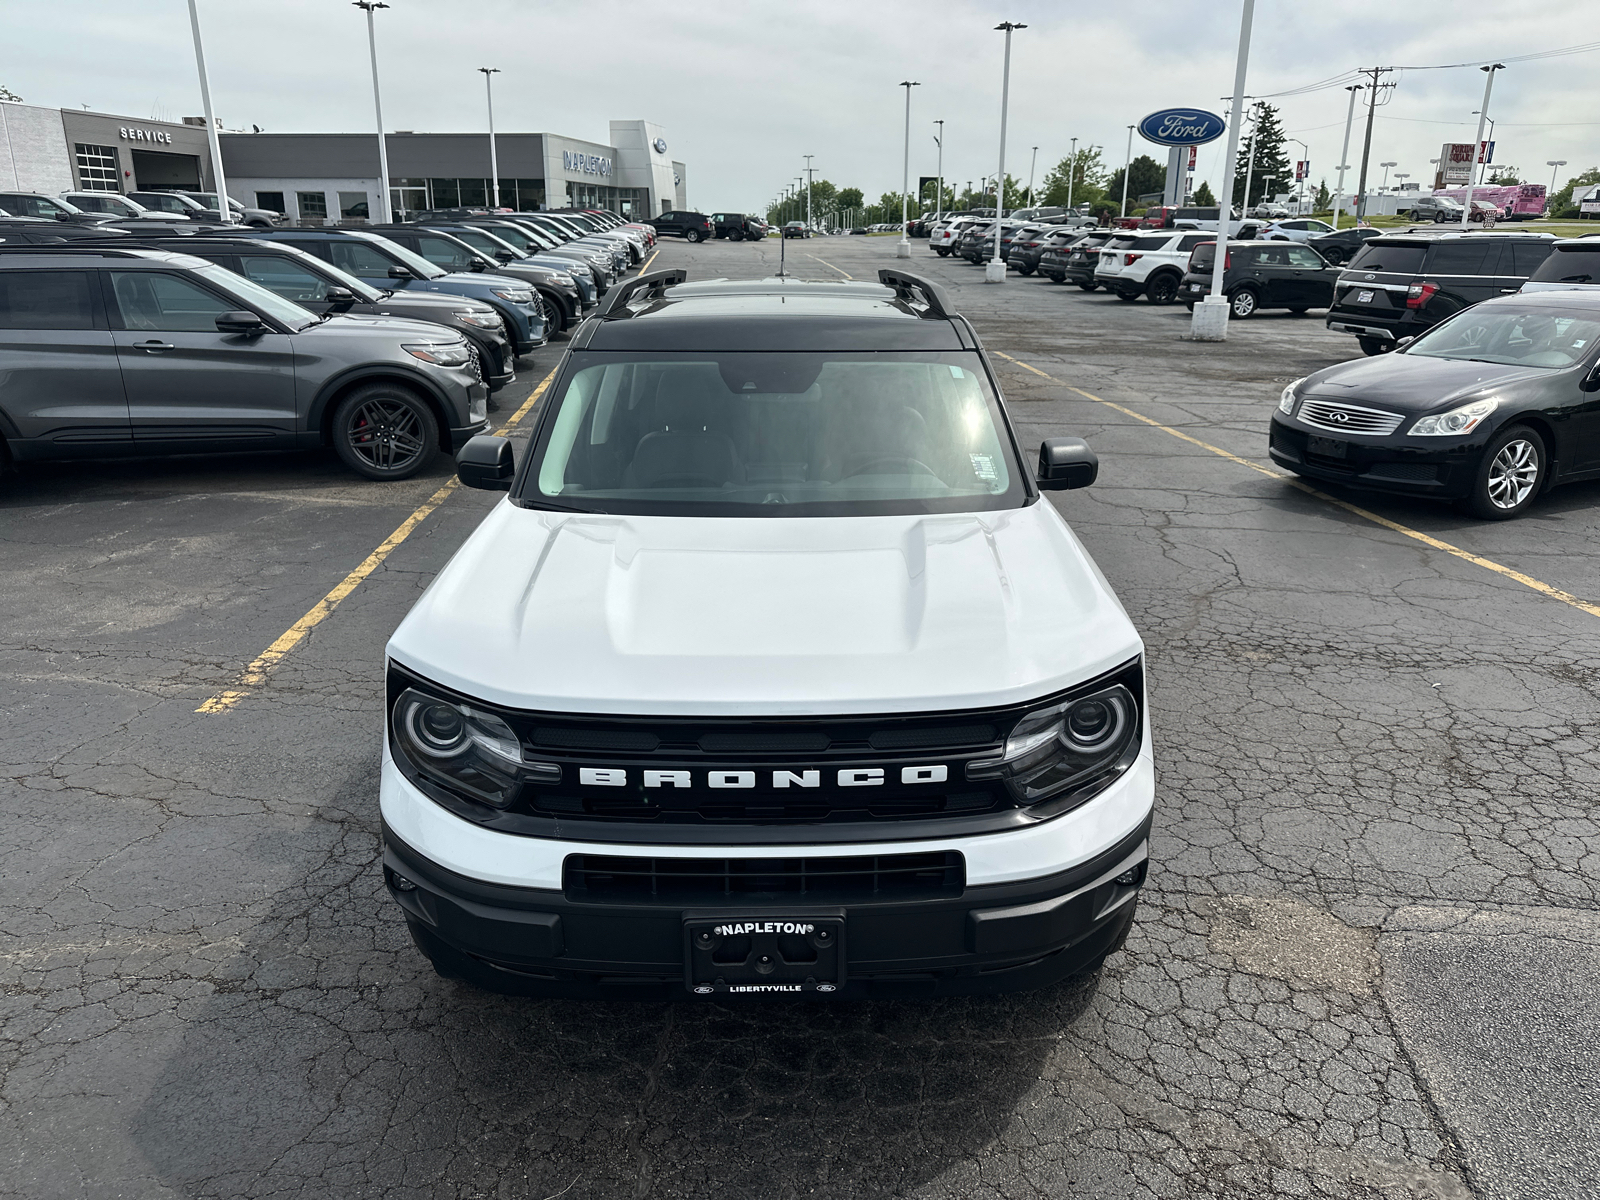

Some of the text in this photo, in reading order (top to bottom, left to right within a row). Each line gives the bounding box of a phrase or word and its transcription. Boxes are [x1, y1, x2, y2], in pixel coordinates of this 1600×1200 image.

[120, 127, 171, 144] SERVICE
[1158, 115, 1209, 137] Ford
[563, 150, 613, 177] NAPLETON
[579, 765, 948, 788] BRONCO
[721, 922, 807, 936] NAPLETON
[729, 985, 802, 993] LIBERTYVILLE
